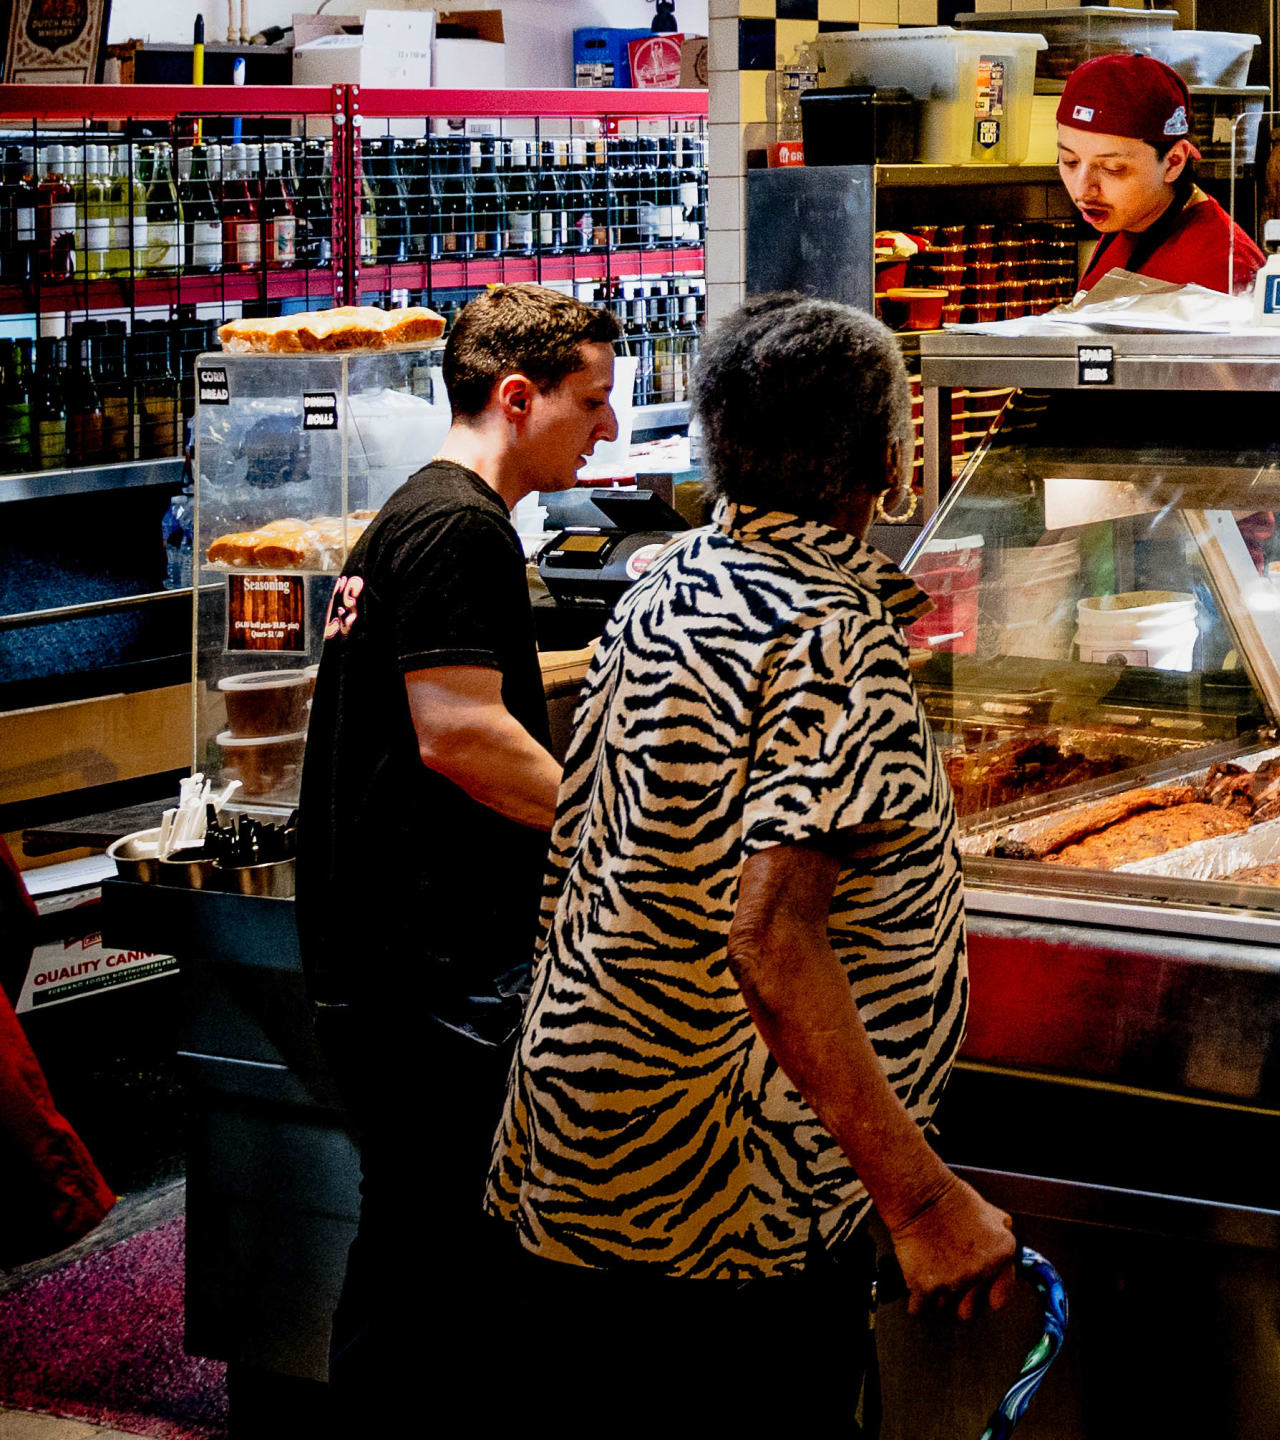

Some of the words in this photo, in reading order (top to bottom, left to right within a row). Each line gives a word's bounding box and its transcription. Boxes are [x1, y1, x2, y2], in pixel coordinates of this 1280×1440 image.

[201, 371, 226, 383] CORN
[200, 388, 229, 401] BREAD
[243, 578, 290, 594] Seasoning
[33, 957, 102, 986] QUALITY
